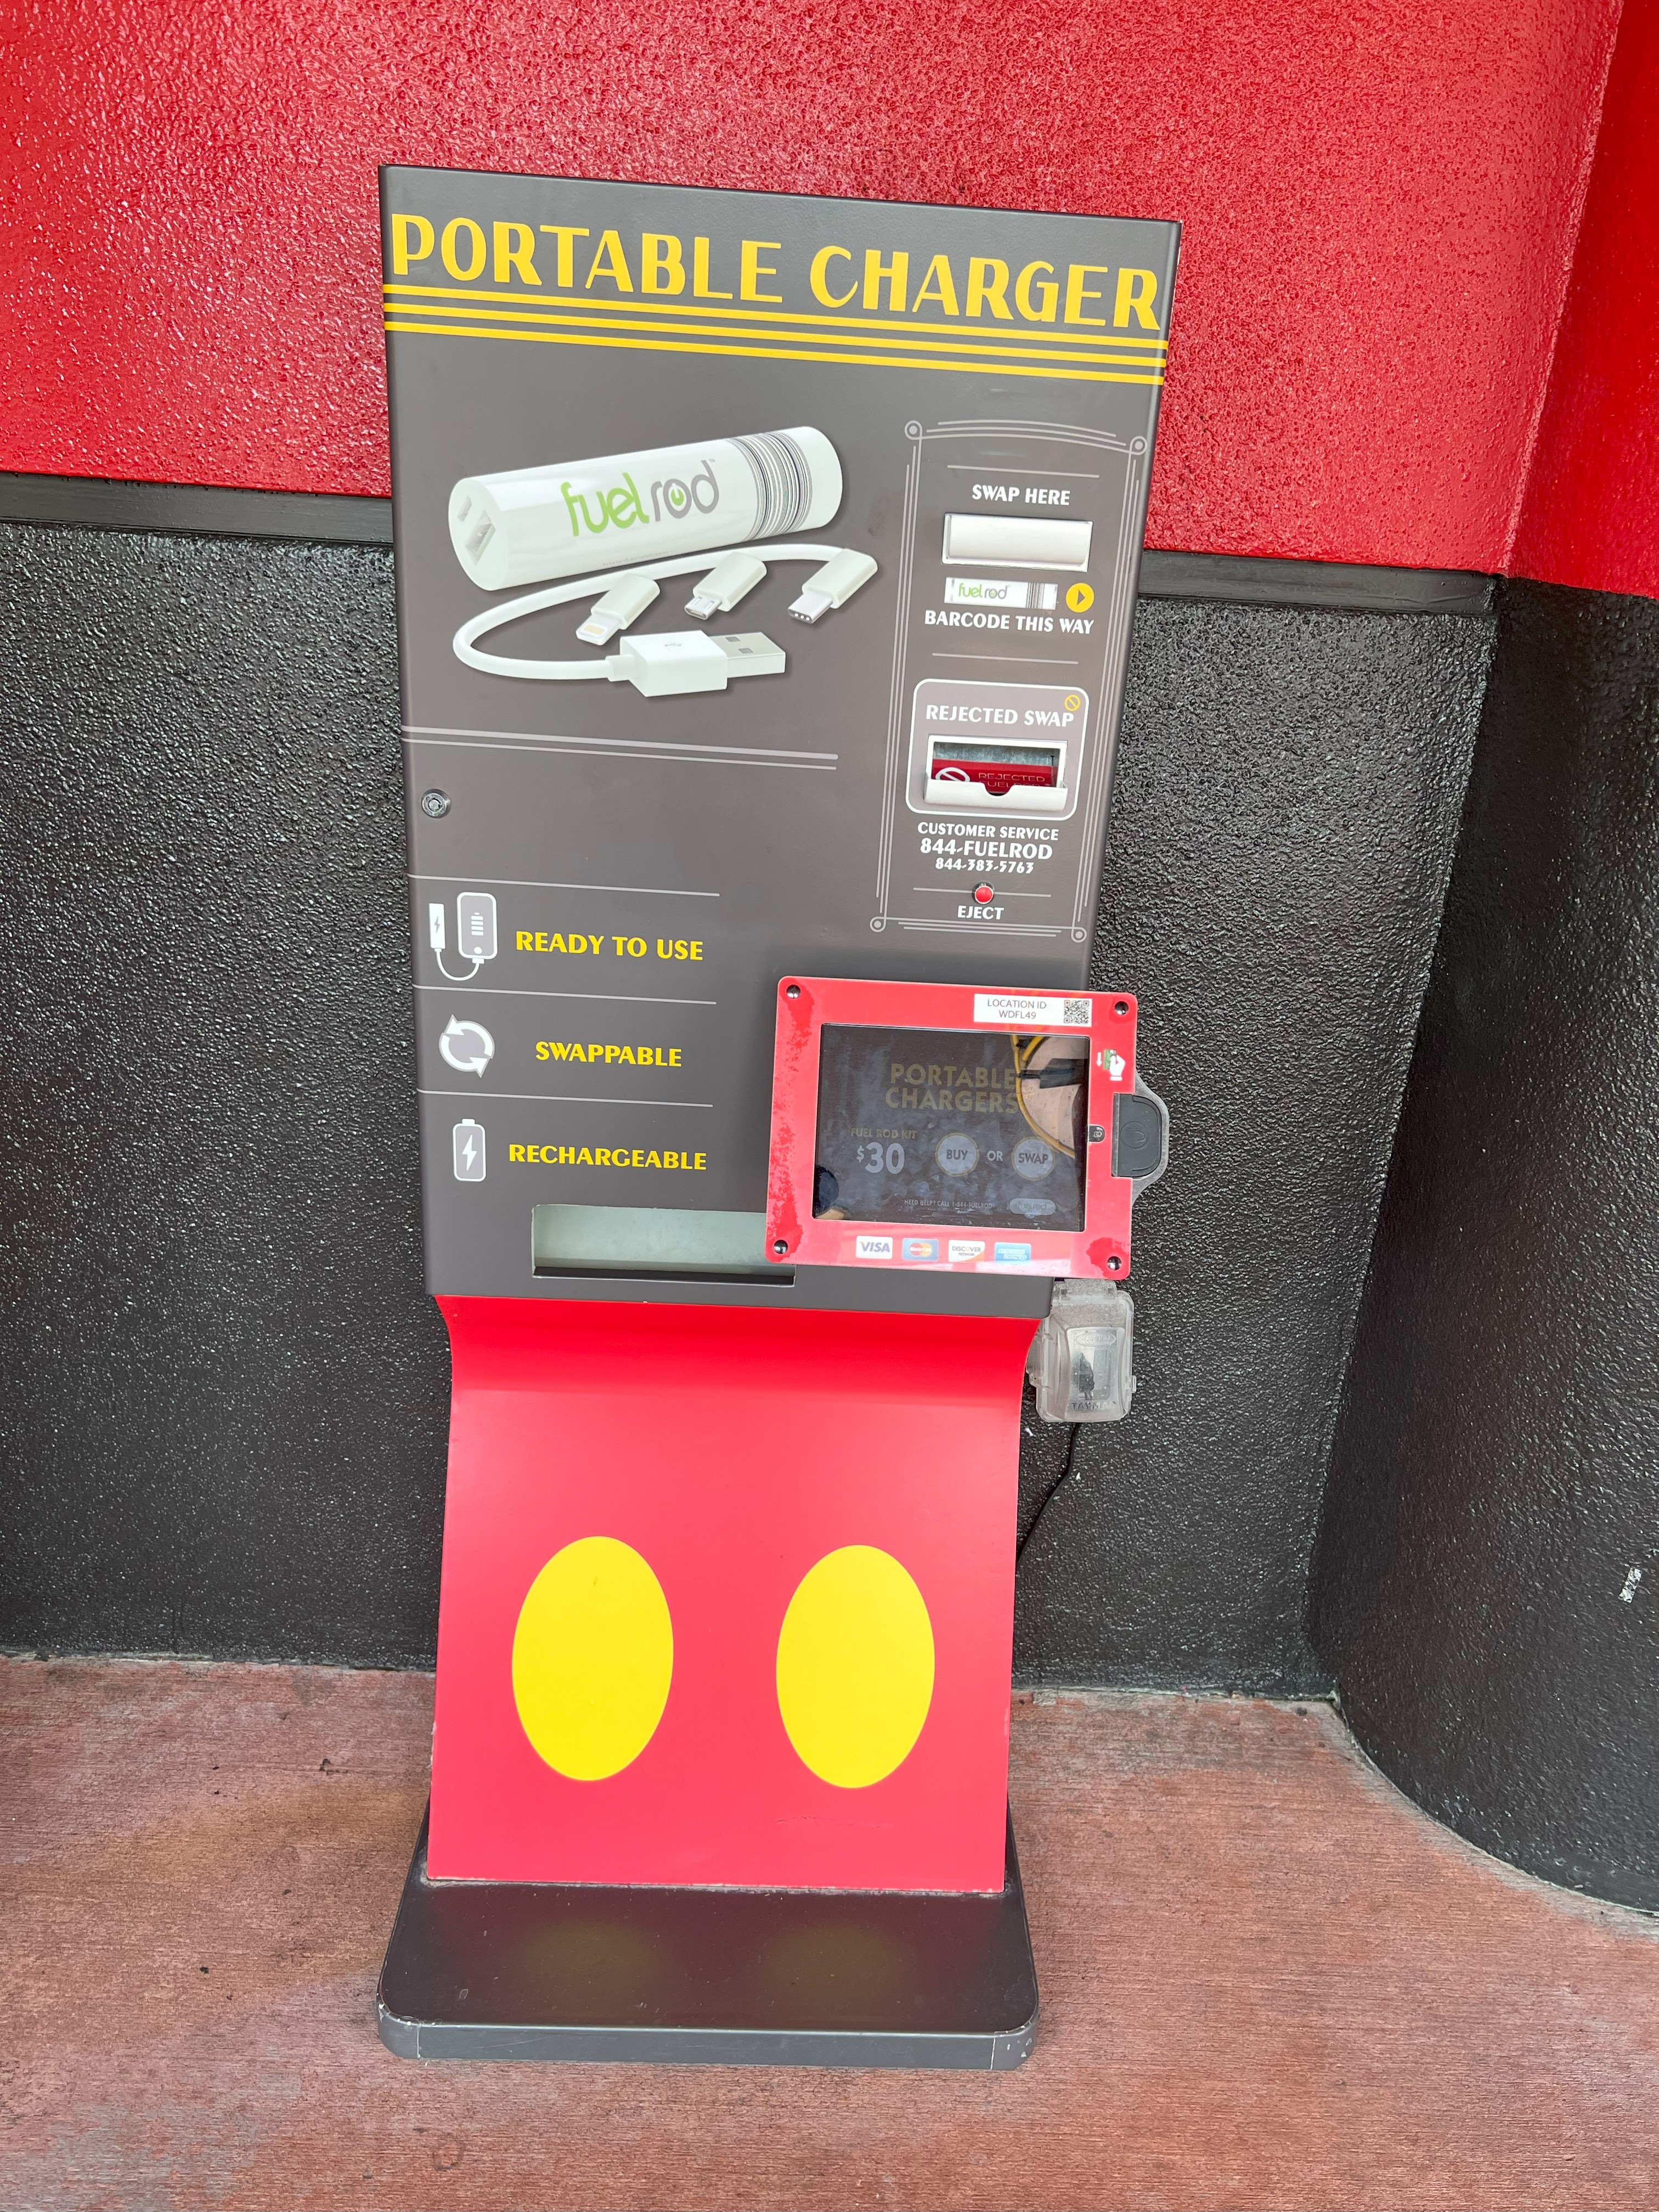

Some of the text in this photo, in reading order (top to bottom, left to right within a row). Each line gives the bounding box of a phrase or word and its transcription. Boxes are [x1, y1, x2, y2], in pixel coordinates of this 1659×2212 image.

[392, 214, 1160, 331] PORTABLE CHARGER
[972, 484, 1071, 505] SWAP HERE
[924, 610, 1094, 634] BARCODE THIS WAY
[926, 704, 1075, 727] REJECTED SWAP
[978, 772, 1046, 782] REJECTED
[917, 822, 1059, 840] CUSTOMER SERVICE
[920, 837, 1053, 860] 844-FUELROD
[935, 857, 1035, 874] 844-383-5763
[957, 905, 1005, 920] EJECT
[516, 931, 703, 961] READY TO USE
[987, 998, 1047, 1009] LOCATION ID
[998, 1009, 1037, 1019] WDFL49
[535, 1041, 682, 1067] SWAPPABLE
[890, 1063, 1016, 1090] PORTABLE
[885, 1087, 1019, 1114] CHARGERS
[850, 1127, 918, 1140] FUEL ROD KIT
[509, 1144, 707, 1170] RECHARGEABLE
[856, 1141, 905, 1175] $30
[946, 1149, 969, 1161] BUY
[987, 1150, 1003, 1162] OR
[1018, 1153, 1049, 1165] SWAP
[859, 1241, 890, 1253] VISA
